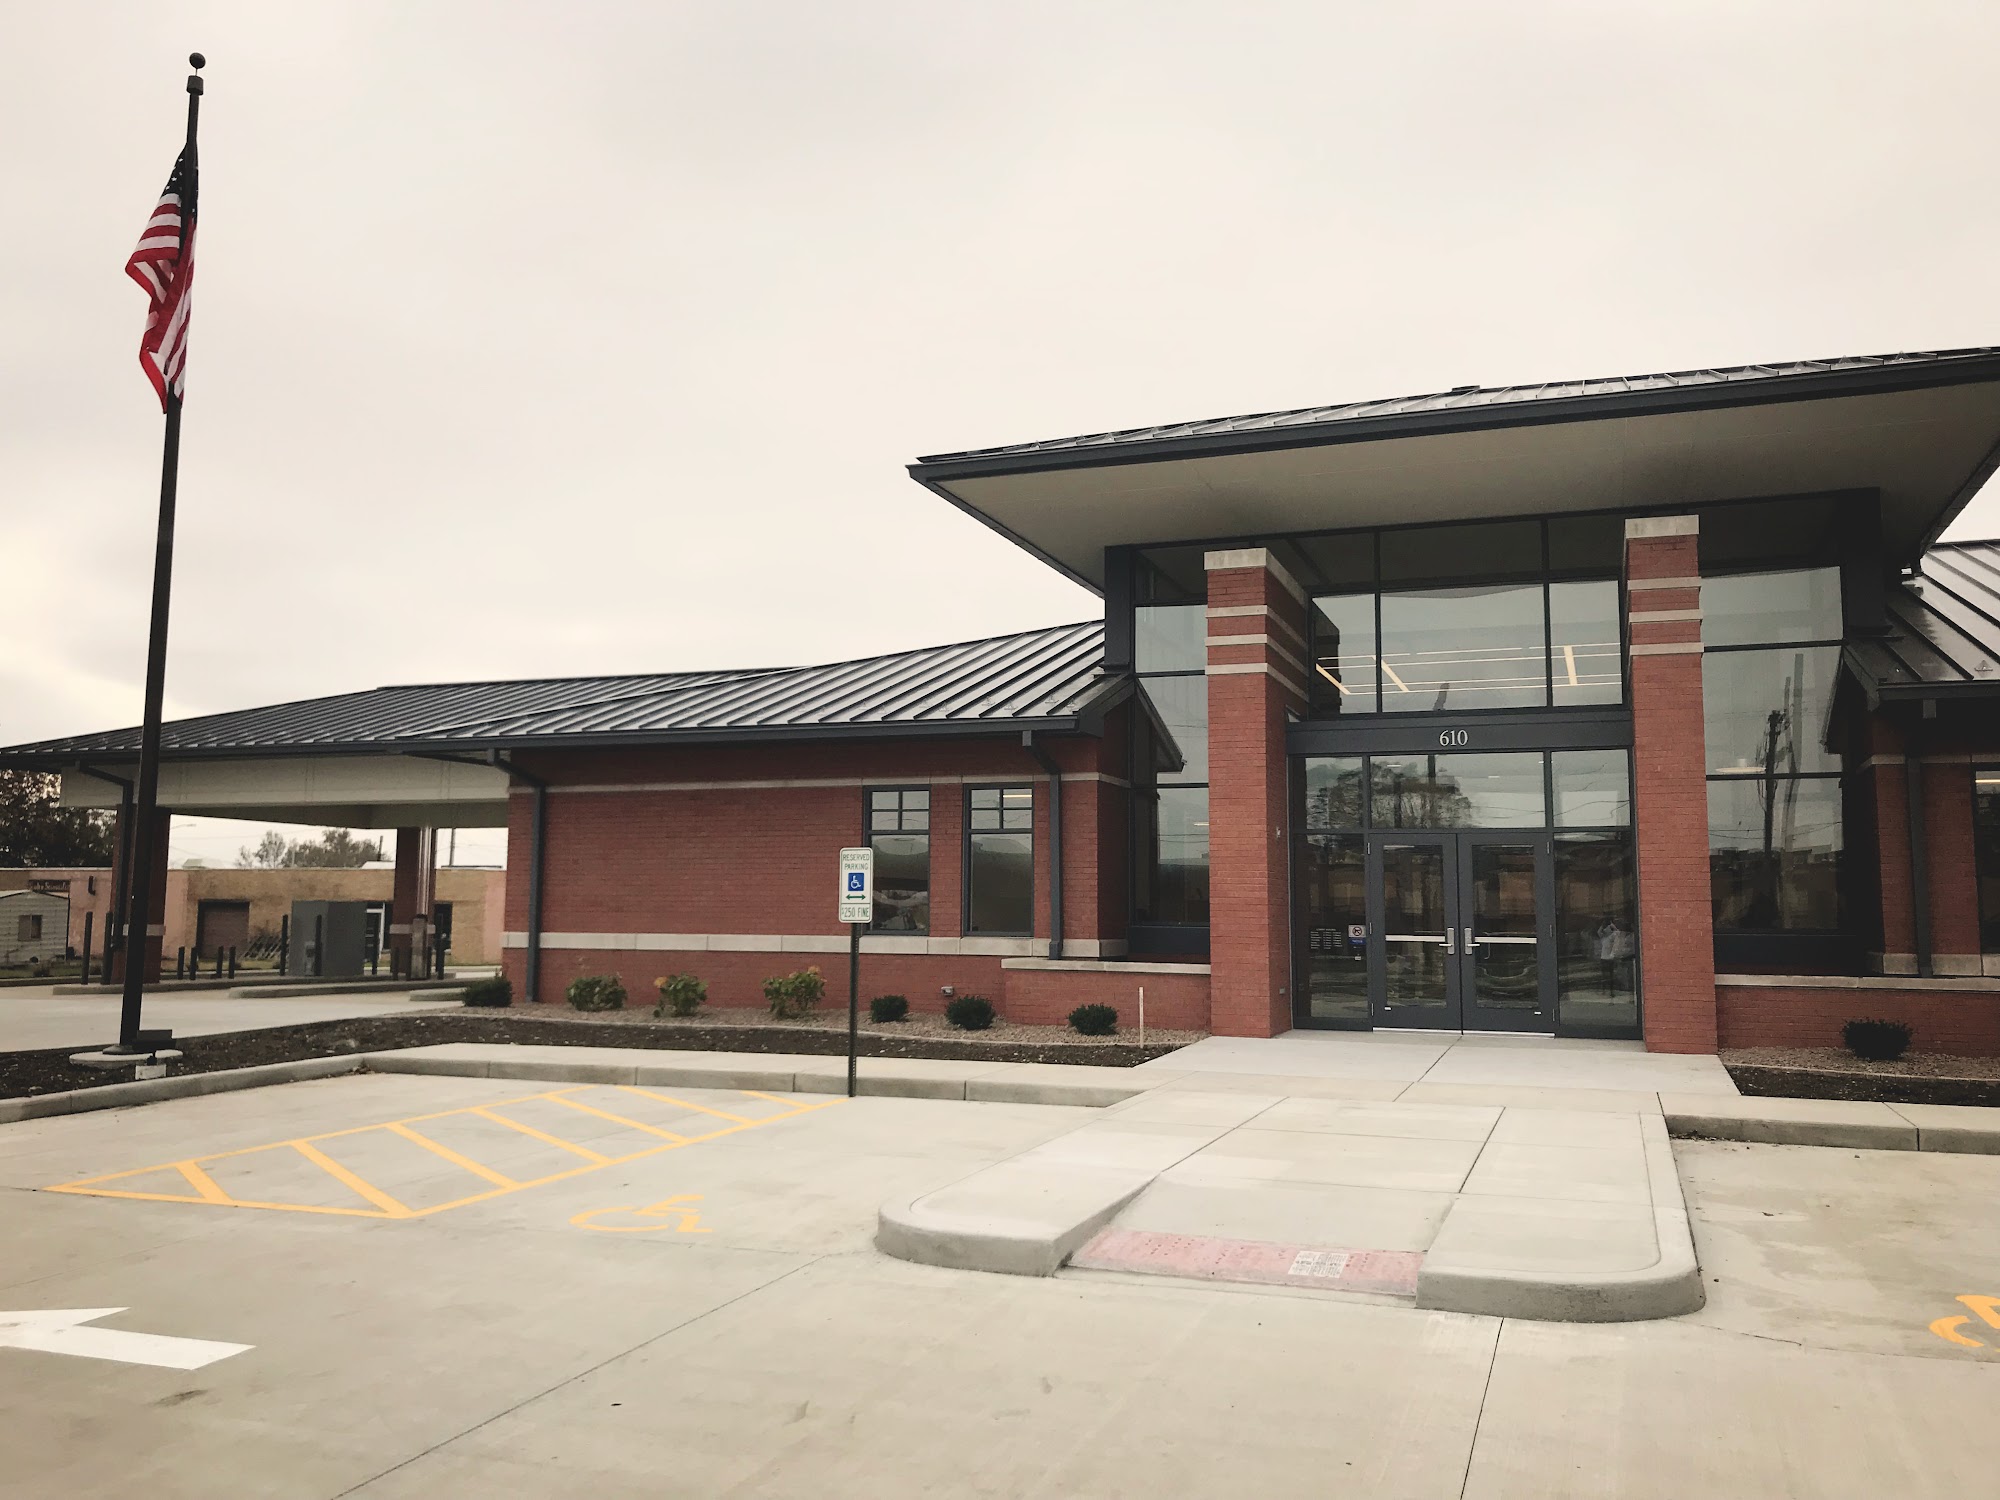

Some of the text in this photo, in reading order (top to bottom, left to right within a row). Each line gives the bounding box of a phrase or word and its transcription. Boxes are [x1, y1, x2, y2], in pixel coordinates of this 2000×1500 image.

[1439, 729, 1469, 747] 610
[842, 853, 870, 862] RESERVED
[844, 862, 869, 871] PARKING
[841, 907, 869, 918] $250 FINE
